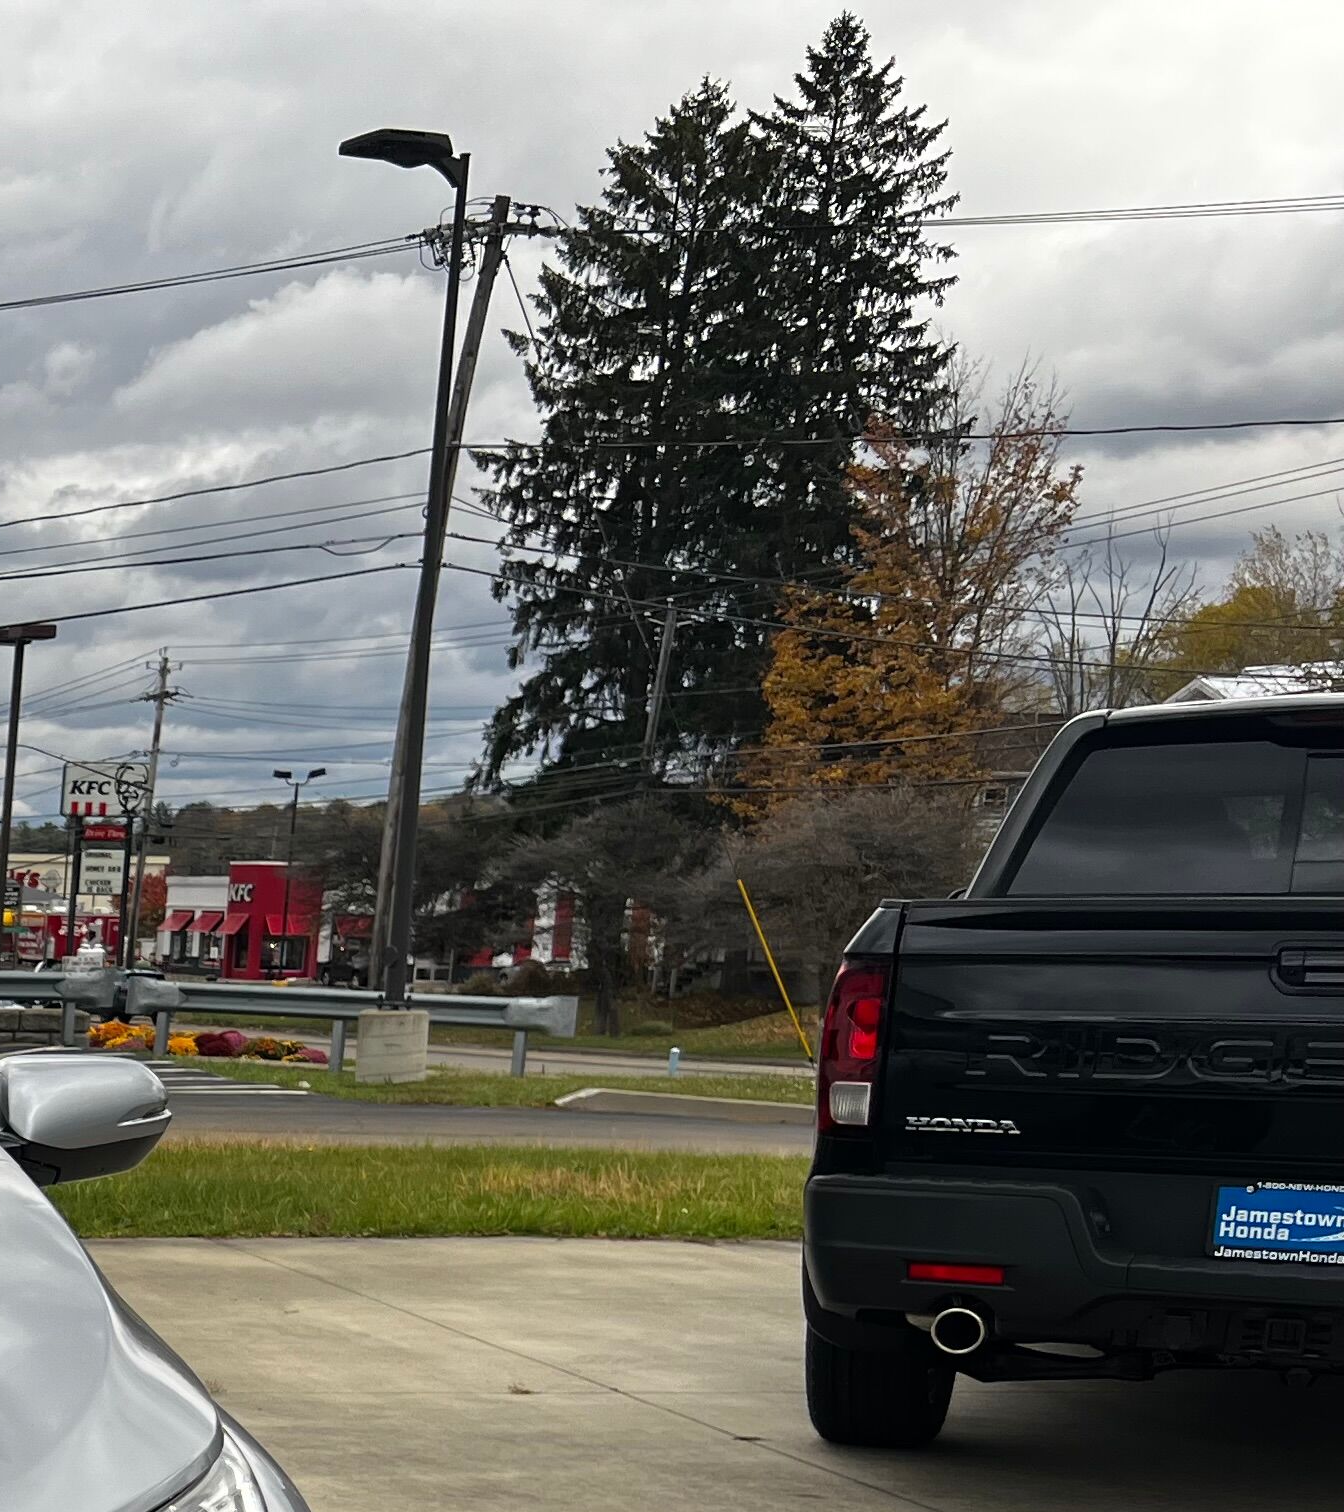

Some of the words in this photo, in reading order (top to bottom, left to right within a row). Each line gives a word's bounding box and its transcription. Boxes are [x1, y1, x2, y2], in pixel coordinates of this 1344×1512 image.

[69, 780, 111, 795] KFC
[228, 883, 253, 902] KFC
[905, 1116, 1021, 1135] HONDA
[1218, 1221, 1290, 1241] Honda
